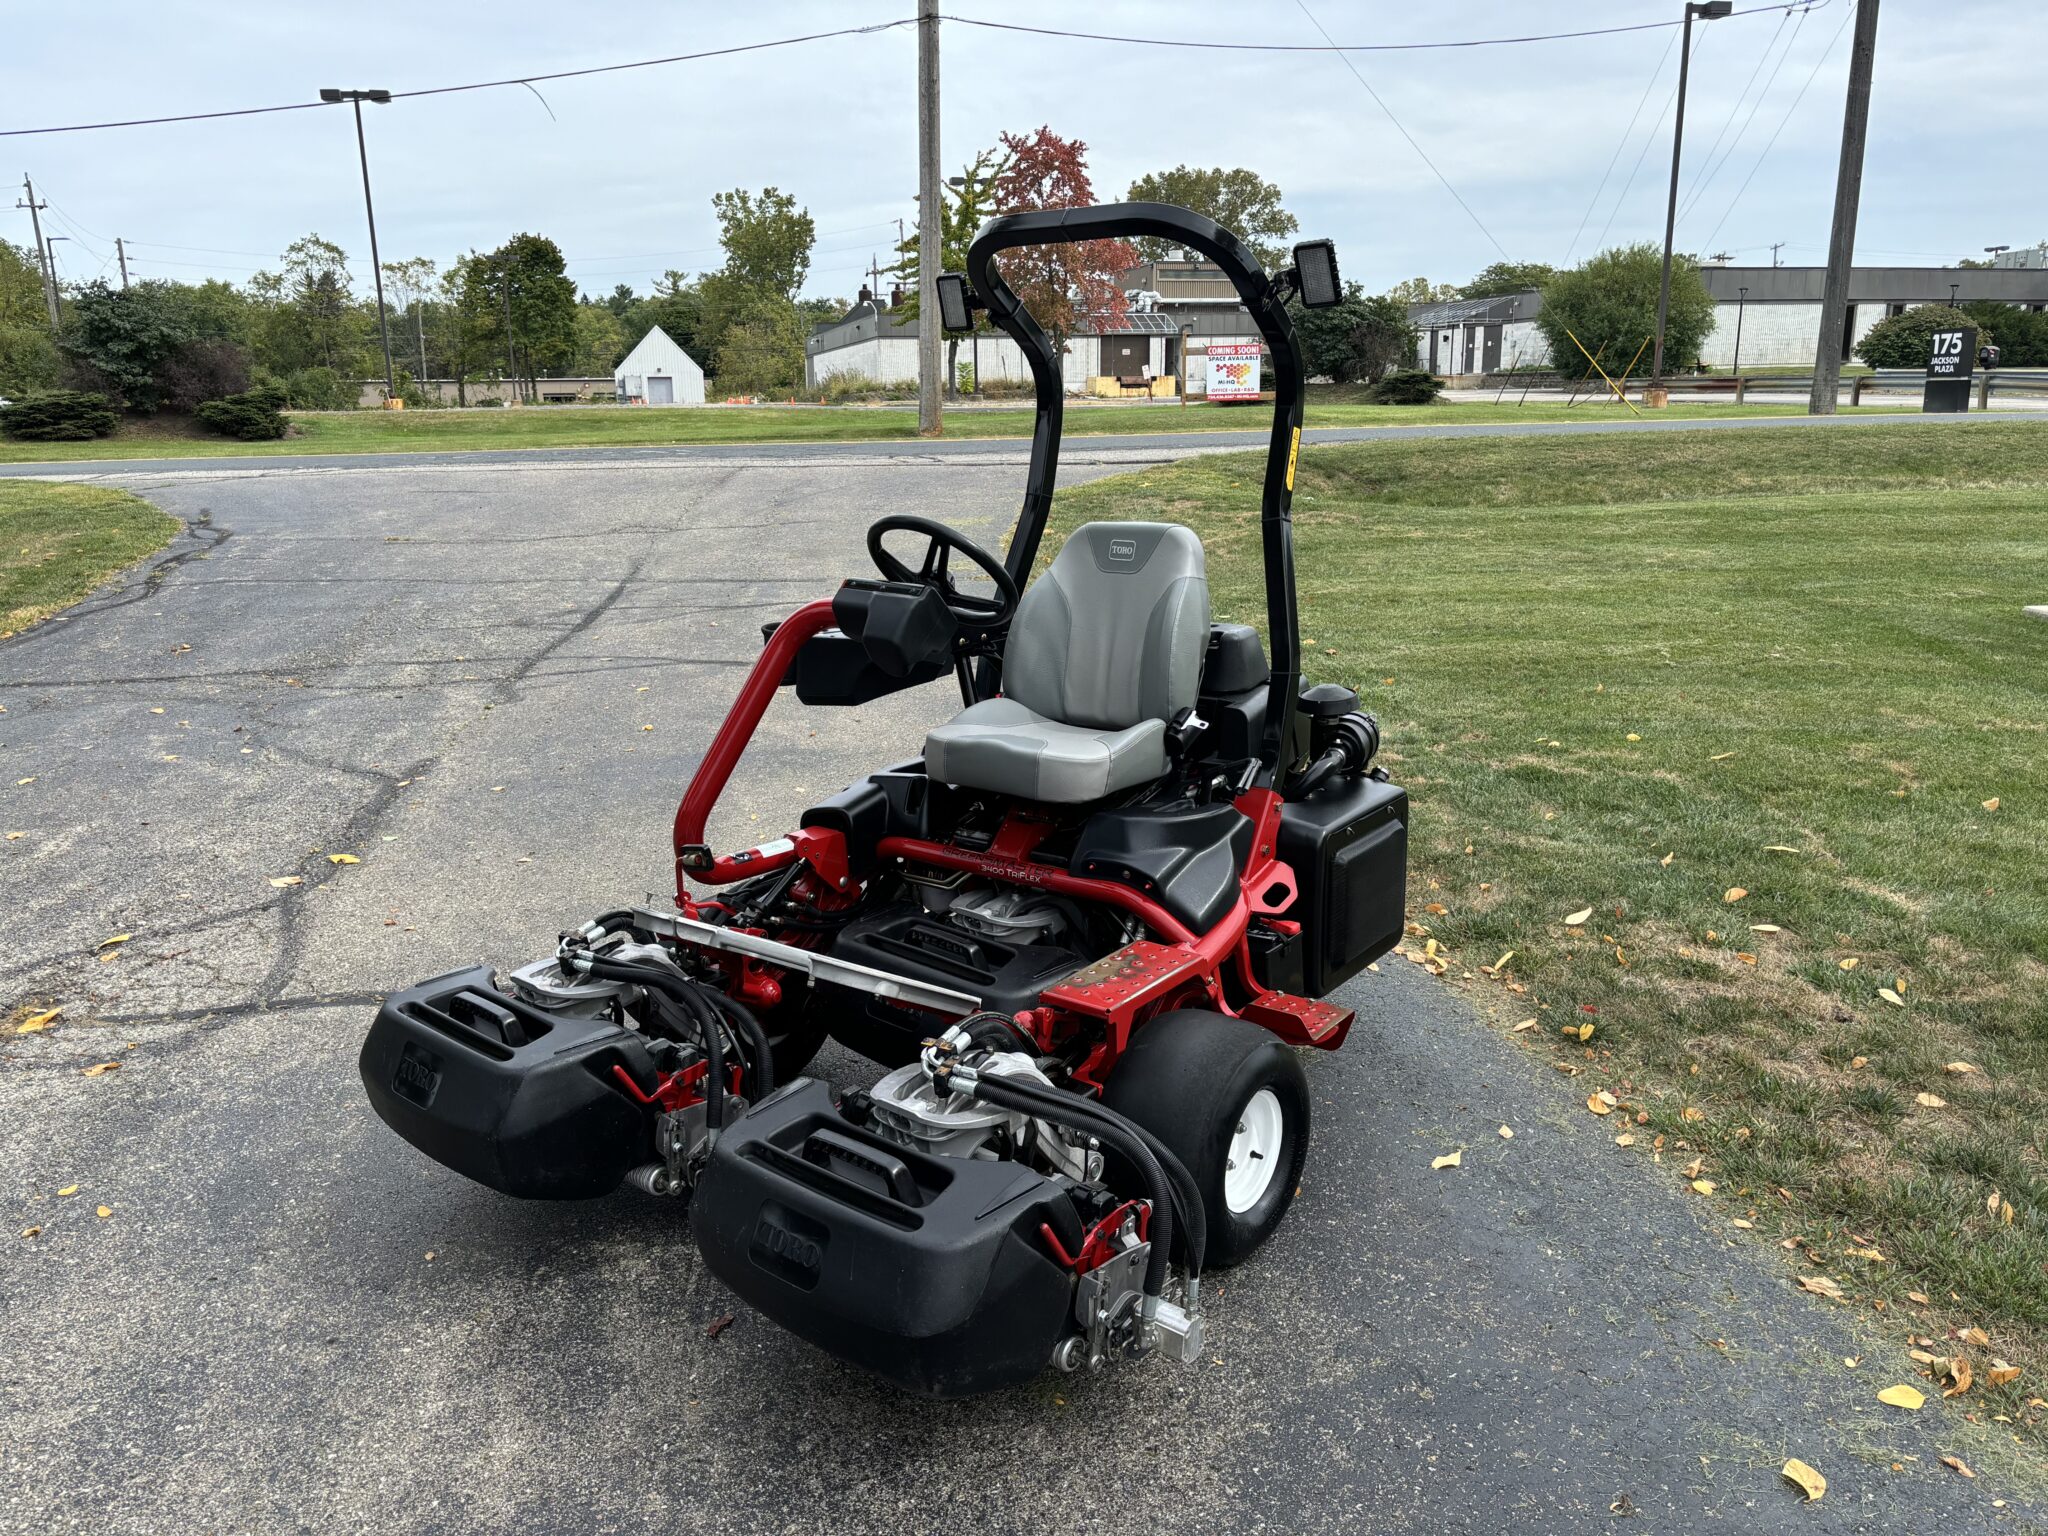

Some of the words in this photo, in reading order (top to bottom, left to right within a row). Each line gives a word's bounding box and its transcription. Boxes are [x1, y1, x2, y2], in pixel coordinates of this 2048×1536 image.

[1933, 333, 1962, 355] 175
[1208, 346, 1235, 355] COMING
[1237, 346, 1259, 354] SOON!
[1931, 356, 1959, 365] JACKSON
[1934, 365, 1954, 373] PLAZA
[1111, 545, 1133, 555] TORO
[981, 864, 1005, 875] 3400
